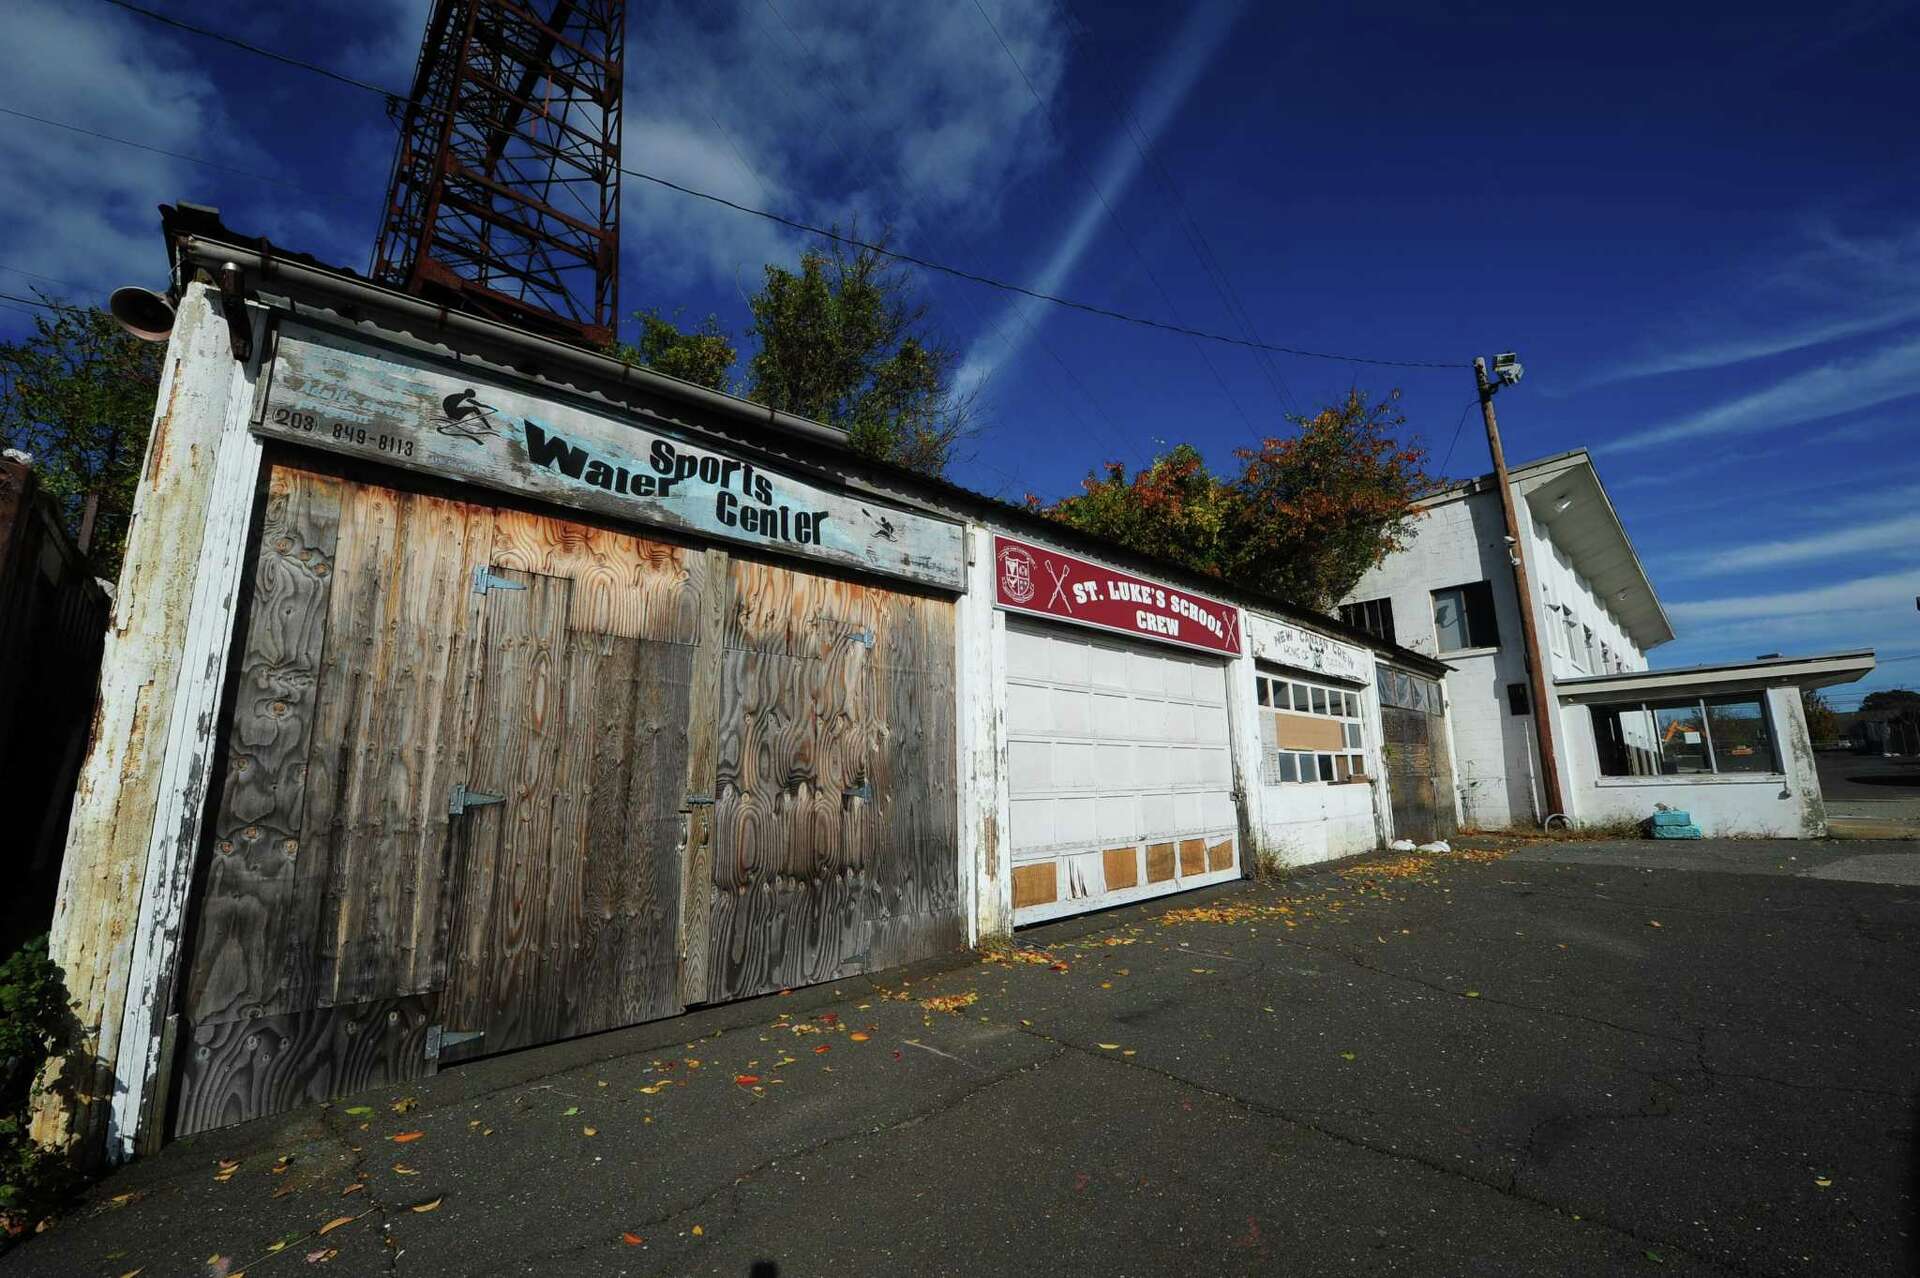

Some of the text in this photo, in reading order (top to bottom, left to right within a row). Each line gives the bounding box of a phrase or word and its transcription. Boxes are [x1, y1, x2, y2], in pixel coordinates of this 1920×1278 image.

[331, 423, 414, 457] 849-8113
[524, 418, 678, 498] Water
[650, 439, 773, 506] Sports
[716, 490, 829, 546] Center
[1072, 581, 1224, 639] ST. LUKE'S SCHOOL
[1136, 610, 1180, 636] CREW
[1274, 629, 1293, 647] NEW
